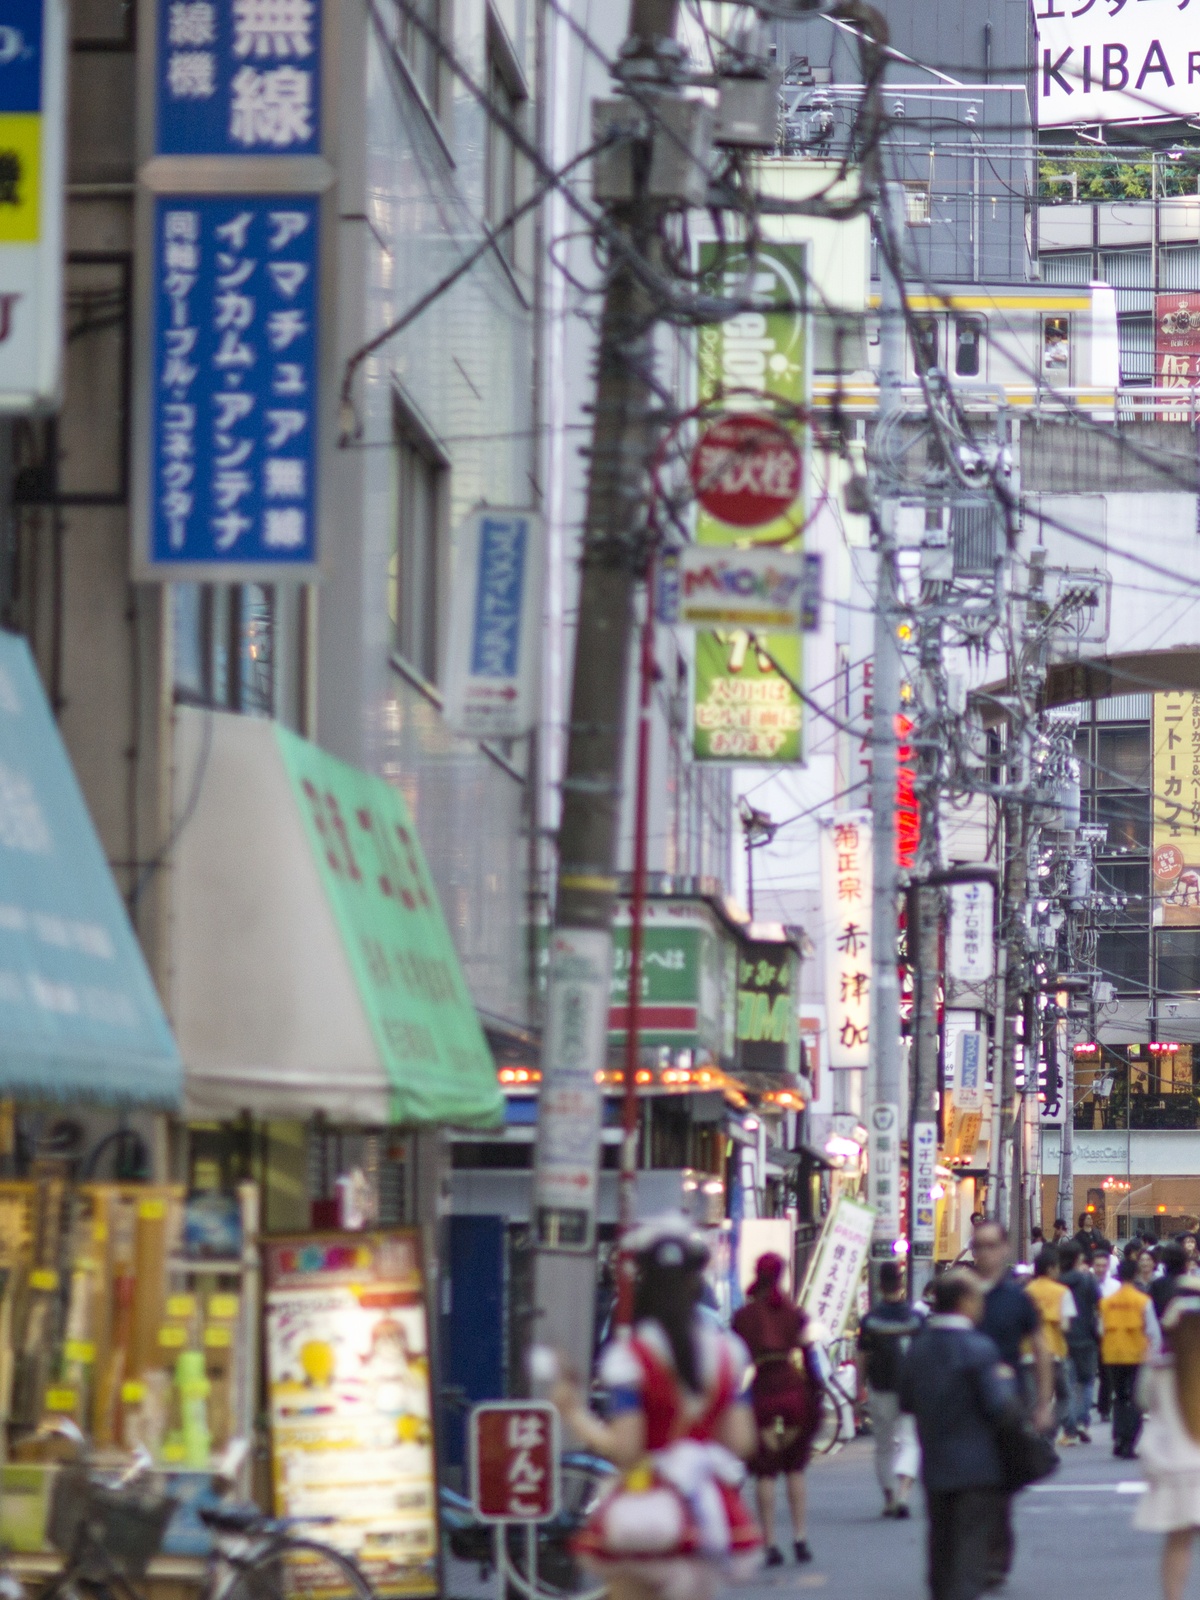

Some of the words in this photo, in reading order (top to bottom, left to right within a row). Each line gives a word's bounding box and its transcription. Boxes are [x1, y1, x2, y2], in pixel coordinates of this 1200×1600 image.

[230, 0, 313, 145] 無線
[1043, 39, 1175, 97] KIBA
[835, 824, 862, 902] 菊正宗
[836, 922, 870, 1048] 赤津加
[507, 1412, 546, 1516] はんこ
